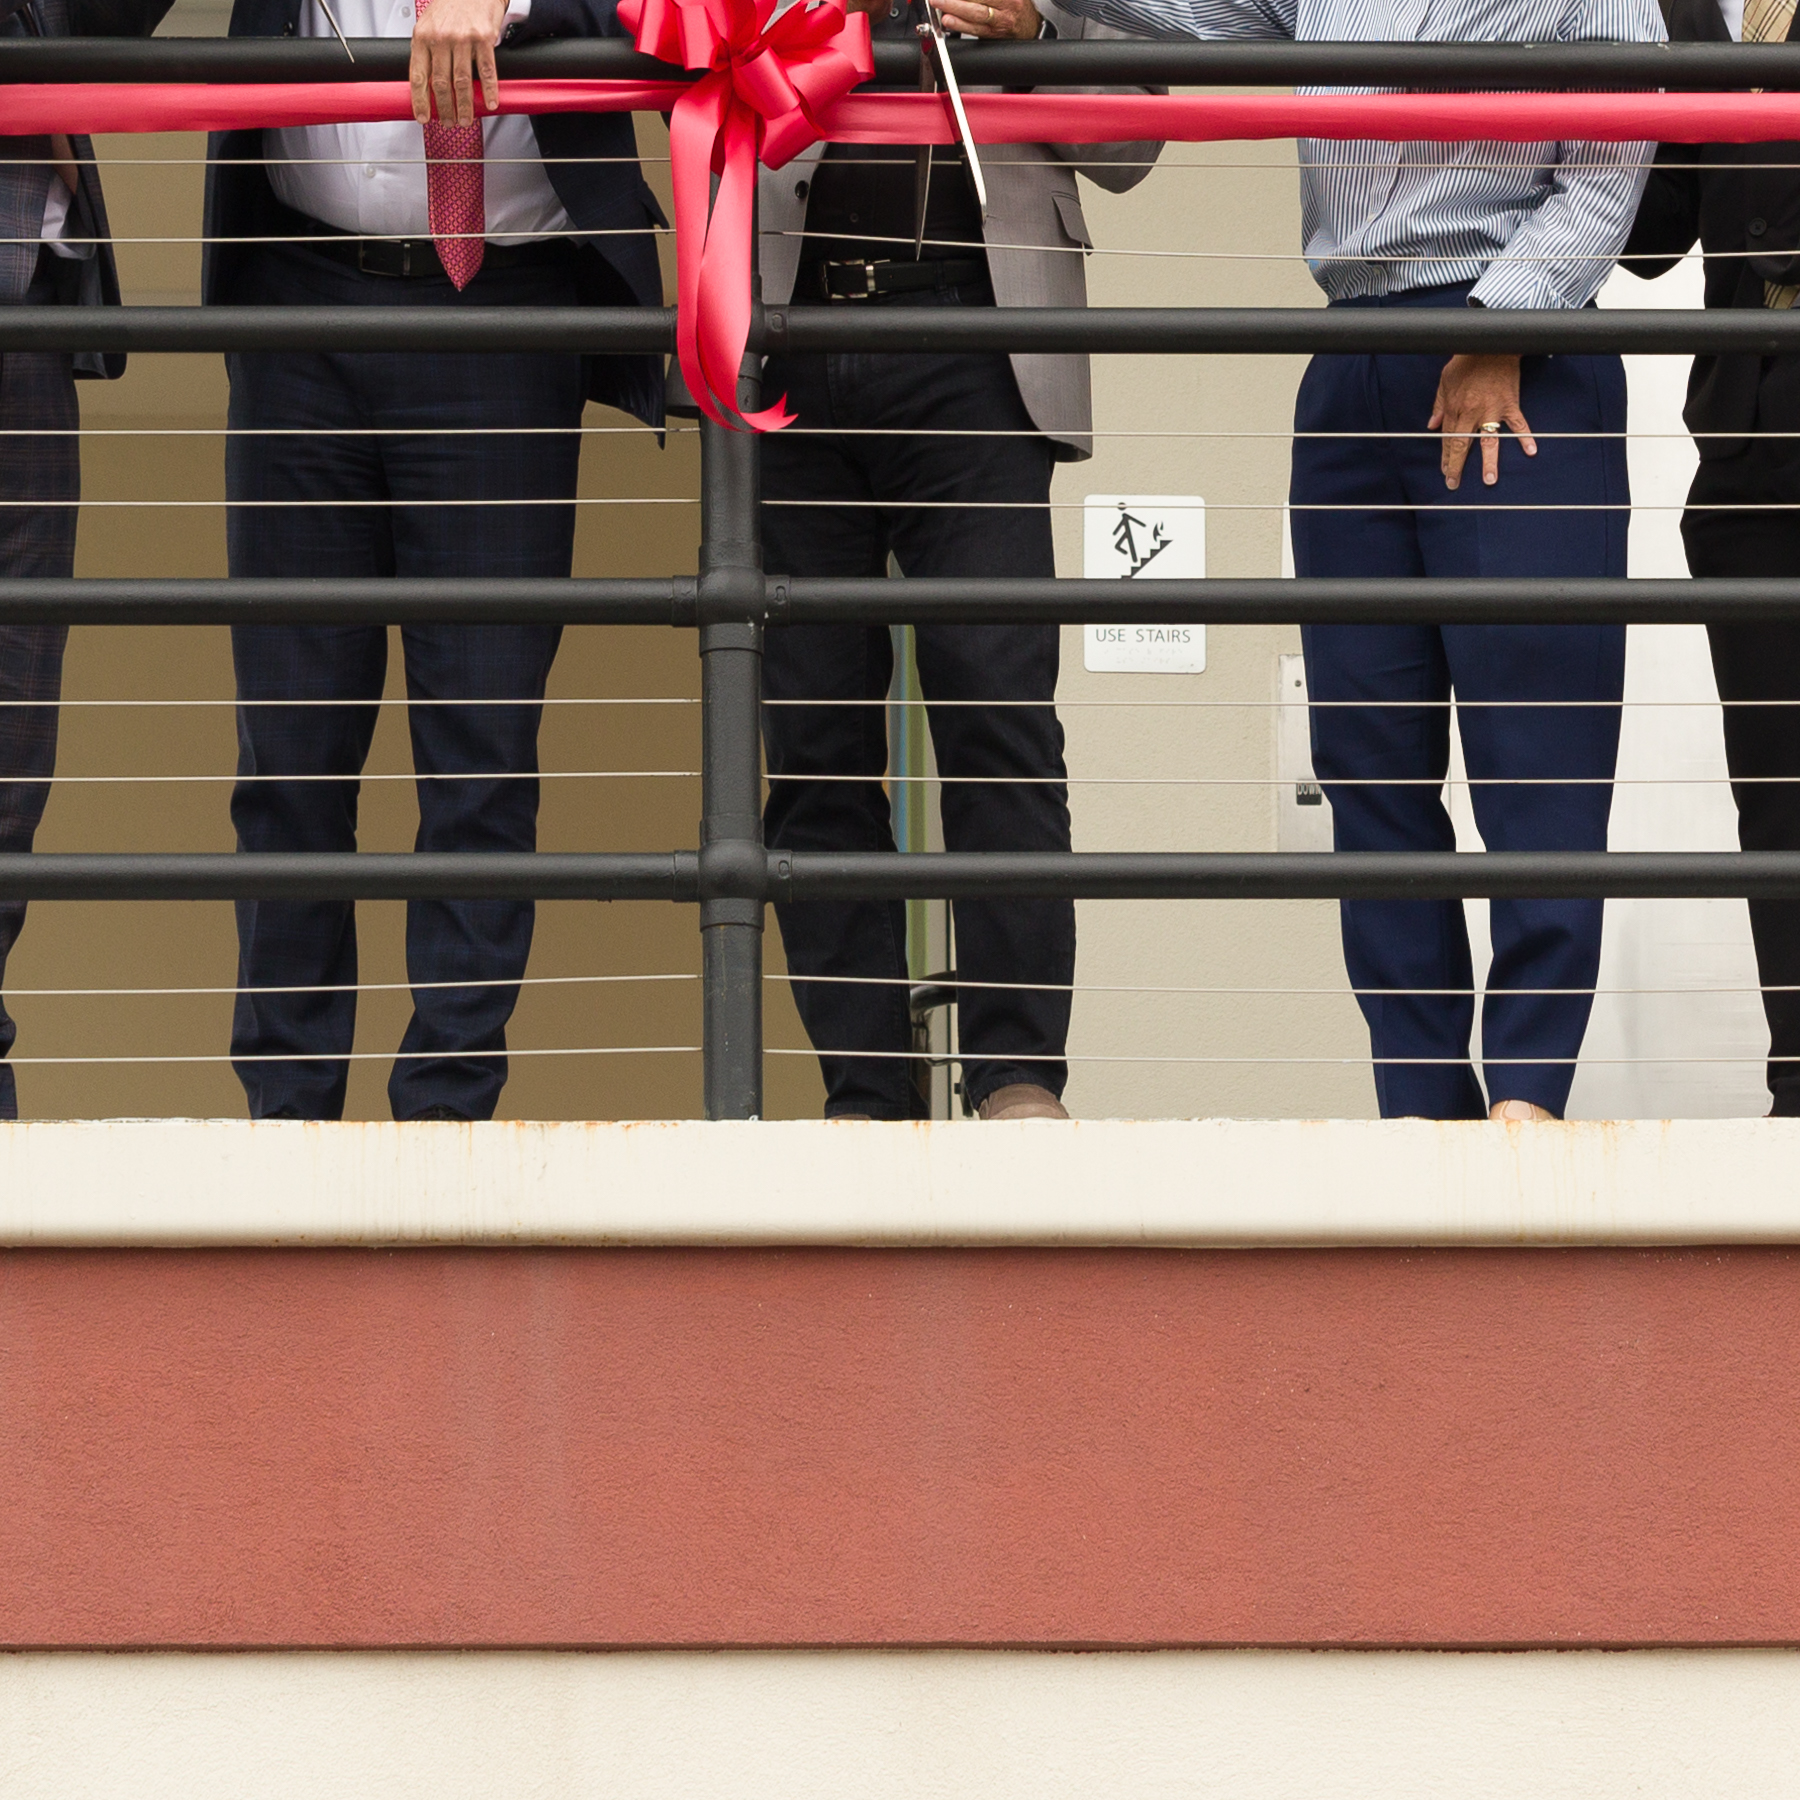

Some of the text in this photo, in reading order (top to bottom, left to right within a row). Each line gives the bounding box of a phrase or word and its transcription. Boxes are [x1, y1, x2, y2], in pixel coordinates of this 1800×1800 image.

[1095, 628, 1191, 643] USE STAIRS
[1297, 783, 1322, 796] DOWN
